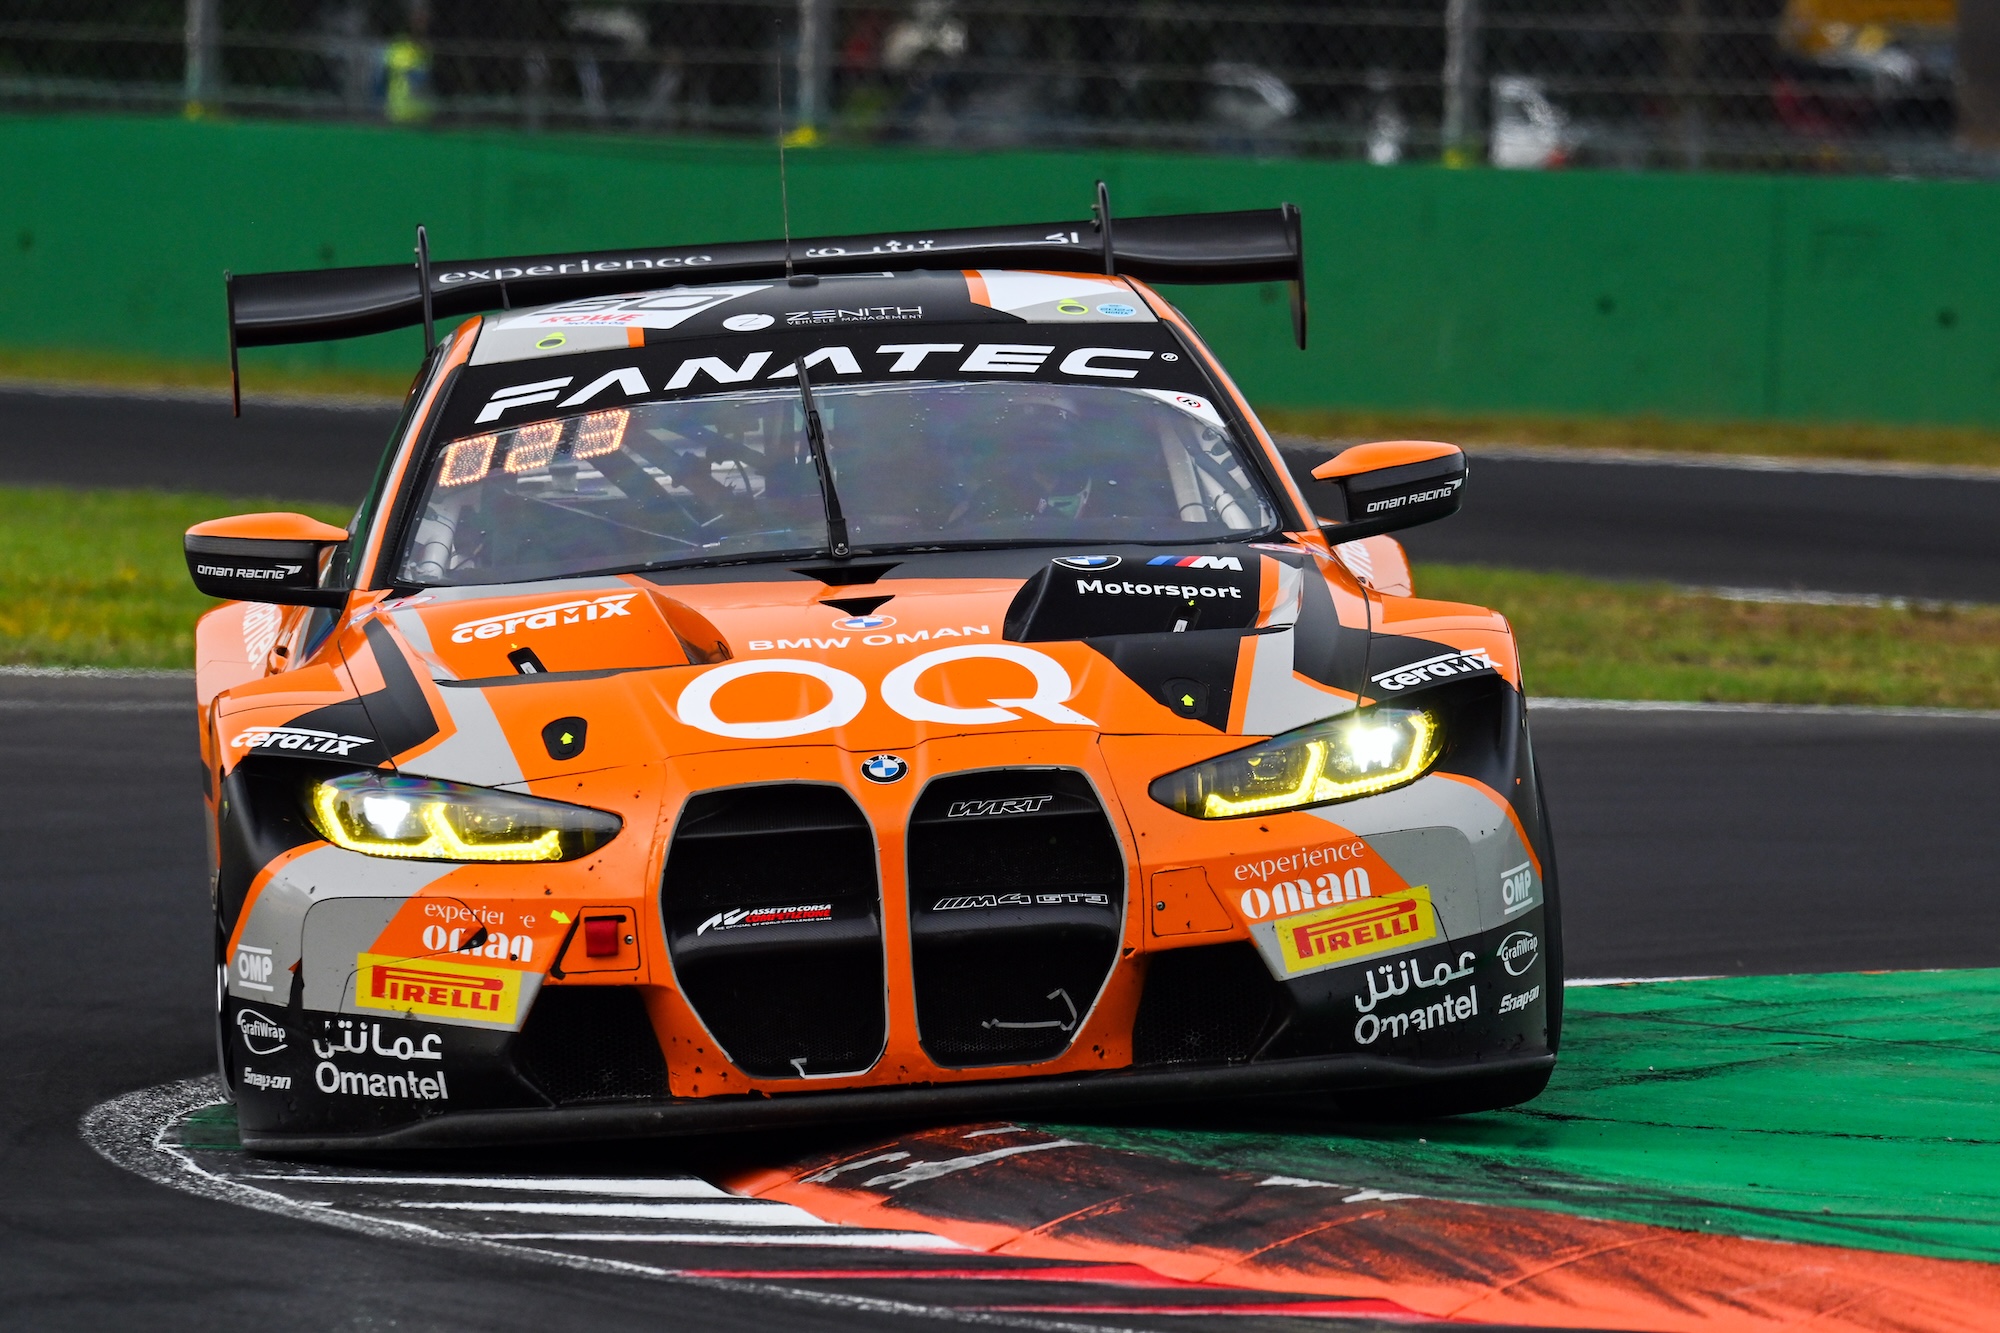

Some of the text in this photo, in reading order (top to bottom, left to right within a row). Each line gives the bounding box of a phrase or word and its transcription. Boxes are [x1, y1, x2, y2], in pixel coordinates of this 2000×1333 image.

[438, 252, 713, 284] experience
[785, 305, 923, 322] ZENITH
[786, 314, 923, 326] VEHICLE MANAGEMENT
[474, 343, 1154, 424] FANATEC
[1076, 579, 1242, 600] Motorsport
[748, 625, 990, 651] BMW OMAN
[947, 795, 1053, 818] WRT
[1234, 840, 1365, 881] experience
[1036, 893, 1109, 905] GT3
[1240, 866, 1372, 919] oman
[1502, 865, 1532, 906] OMP
[424, 903, 536, 929] experiee
[750, 904, 832, 916] ASSETTO CORSA
[1292, 898, 1419, 960] PIRELLI
[1501, 933, 1538, 962] GrafiWrap
[238, 952, 273, 983] OMP
[1354, 950, 1476, 1013] عمانتل
[371, 965, 504, 1012] PIRELLI
[1498, 984, 1540, 1015] Snap-on
[240, 1018, 286, 1043] GrafiWrap
[1354, 985, 1479, 1045] Omantel
[243, 1066, 292, 1091] Snap-on
[315, 1061, 449, 1100] Omantel
